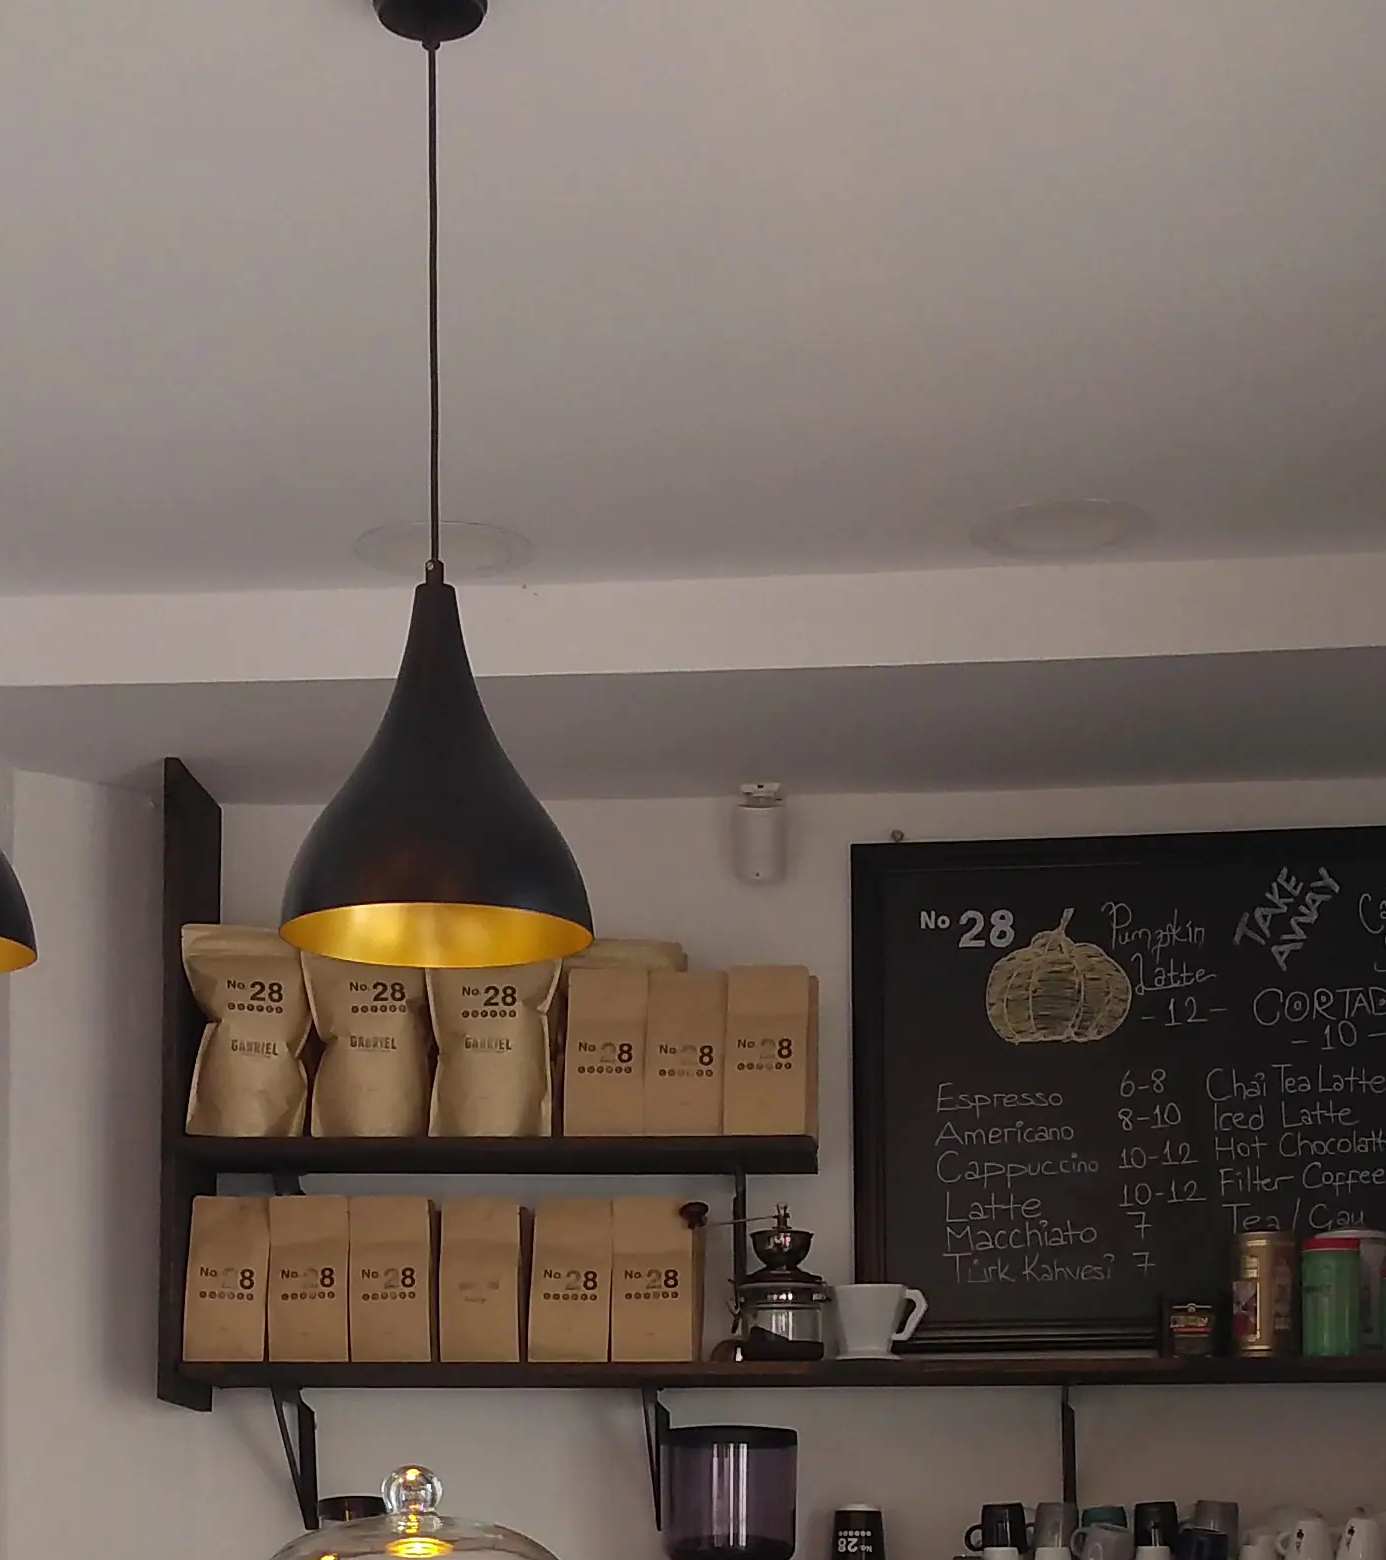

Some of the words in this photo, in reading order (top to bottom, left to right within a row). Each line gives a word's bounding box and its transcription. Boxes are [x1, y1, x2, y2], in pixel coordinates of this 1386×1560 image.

[1233, 866, 1304, 946] TAKE
[1270, 866, 1341, 972] AWAY
[919, 910, 951, 930] No
[958, 908, 1015, 949] 28
[1101, 901, 1206, 964] Pumpkin
[249, 981, 284, 1003] 28
[372, 981, 407, 1002] 28
[1130, 953, 1218, 996] Latte
[483, 985, 517, 1007] 28
[936, 1082, 1063, 1119] Espresso
[1119, 1068, 1166, 1098] 6-8
[1205, 1067, 1266, 1101] Chai
[1271, 1063, 1312, 1094] Tea
[1318, 1064, 1386, 1094] Latte
[935, 1120, 1074, 1146] Americano
[1117, 1102, 1181, 1131] 8-10
[1213, 1102, 1265, 1132] Iced
[1281, 1100, 1361, 1129] Latte
[936, 1150, 1099, 1189] Cappuccino
[1117, 1140, 1199, 1169] 10-12
[1215, 1135, 1268, 1161] Hot
[1219, 1165, 1295, 1197] Filter
[1302, 1161, 1386, 1197] Coffee
[946, 1191, 1042, 1223] Latte
[1117, 1180, 1207, 1208] 10-12
[1222, 1202, 1281, 1236] Tea
[946, 1219, 1098, 1251] Macchiato
[1126, 1210, 1153, 1239] 7
[645, 1269, 679, 1289] 28
[1023, 1252, 1115, 1283] Kahvesi
[1132, 1251, 1157, 1276] 7
[838, 1538, 858, 1552] 28
